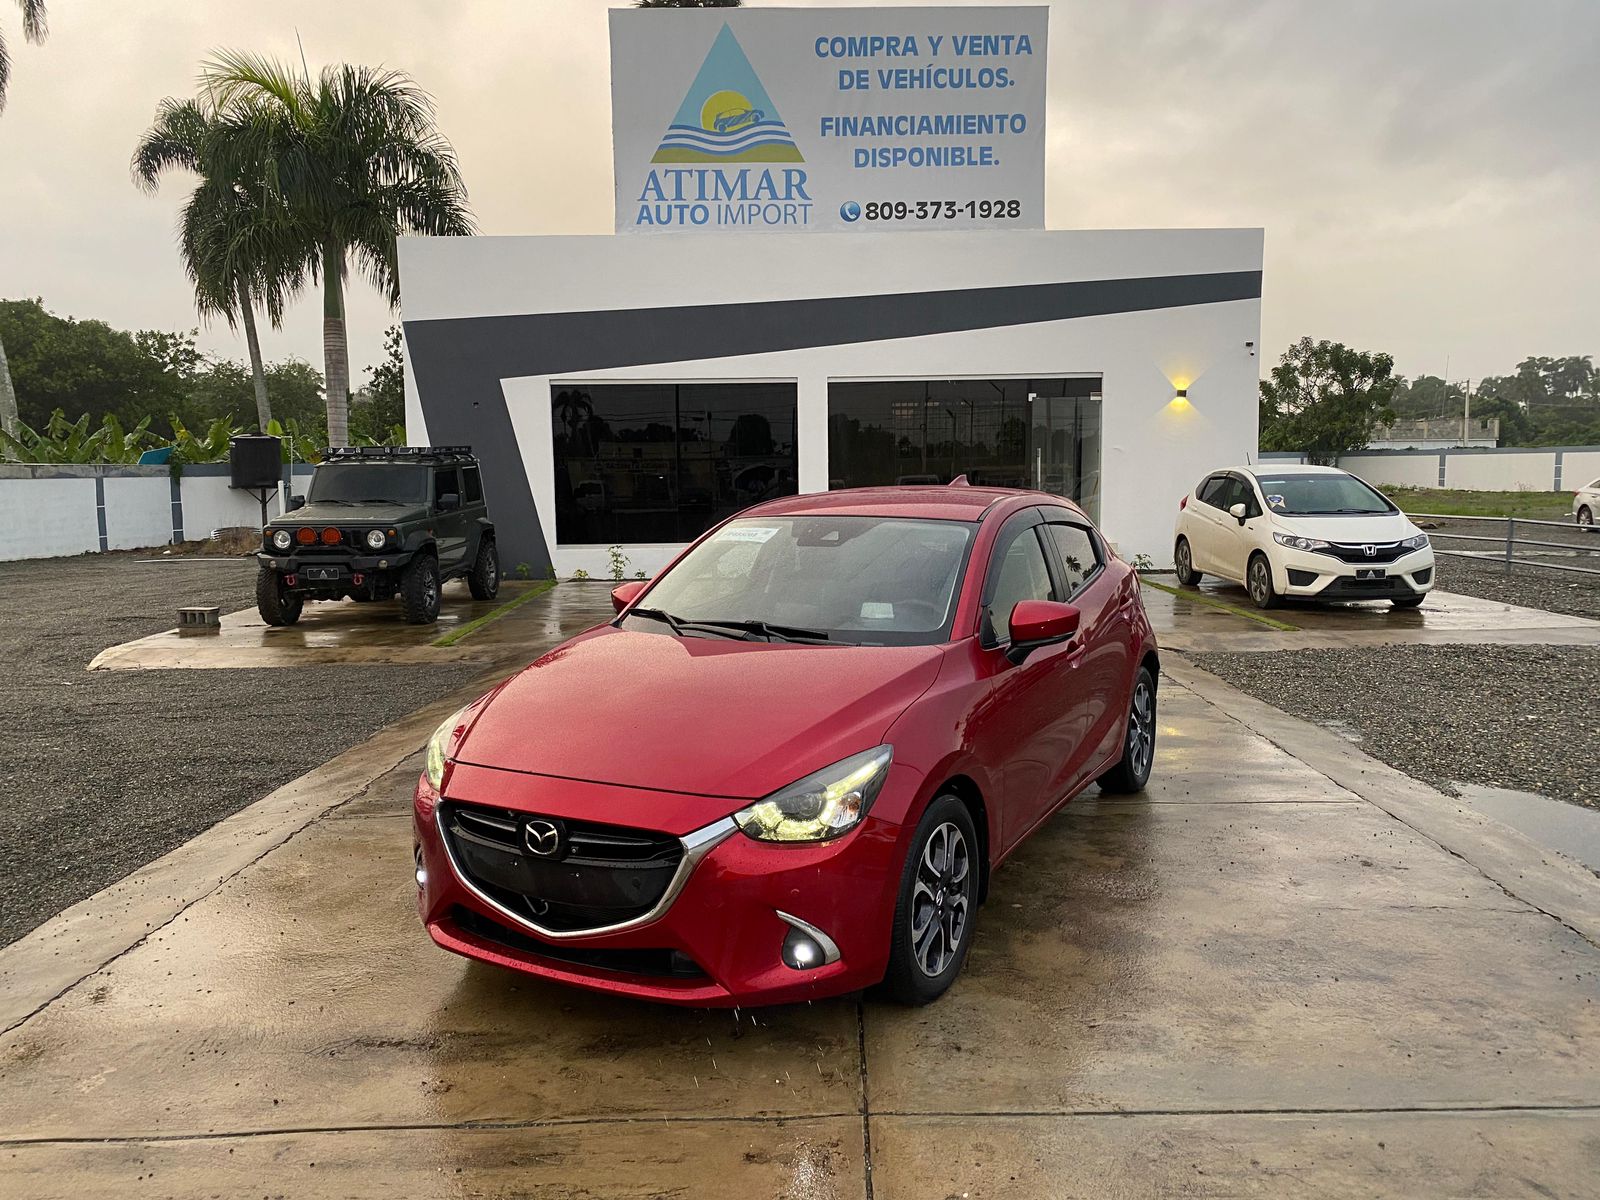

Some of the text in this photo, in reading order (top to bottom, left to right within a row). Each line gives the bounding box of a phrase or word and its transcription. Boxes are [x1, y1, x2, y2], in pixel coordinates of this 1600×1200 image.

[814, 34, 1033, 58] COMPRA Y VENTA
[838, 64, 1016, 90] DE VEHÍCULOS.
[820, 114, 1027, 136] FINANCIAMIENTO
[854, 146, 1000, 168] DISPONIBLE.
[637, 168, 812, 202] ATIMAR
[636, 203, 813, 225] AUTO IMPORT
[865, 200, 1021, 221] 809-373-1928
